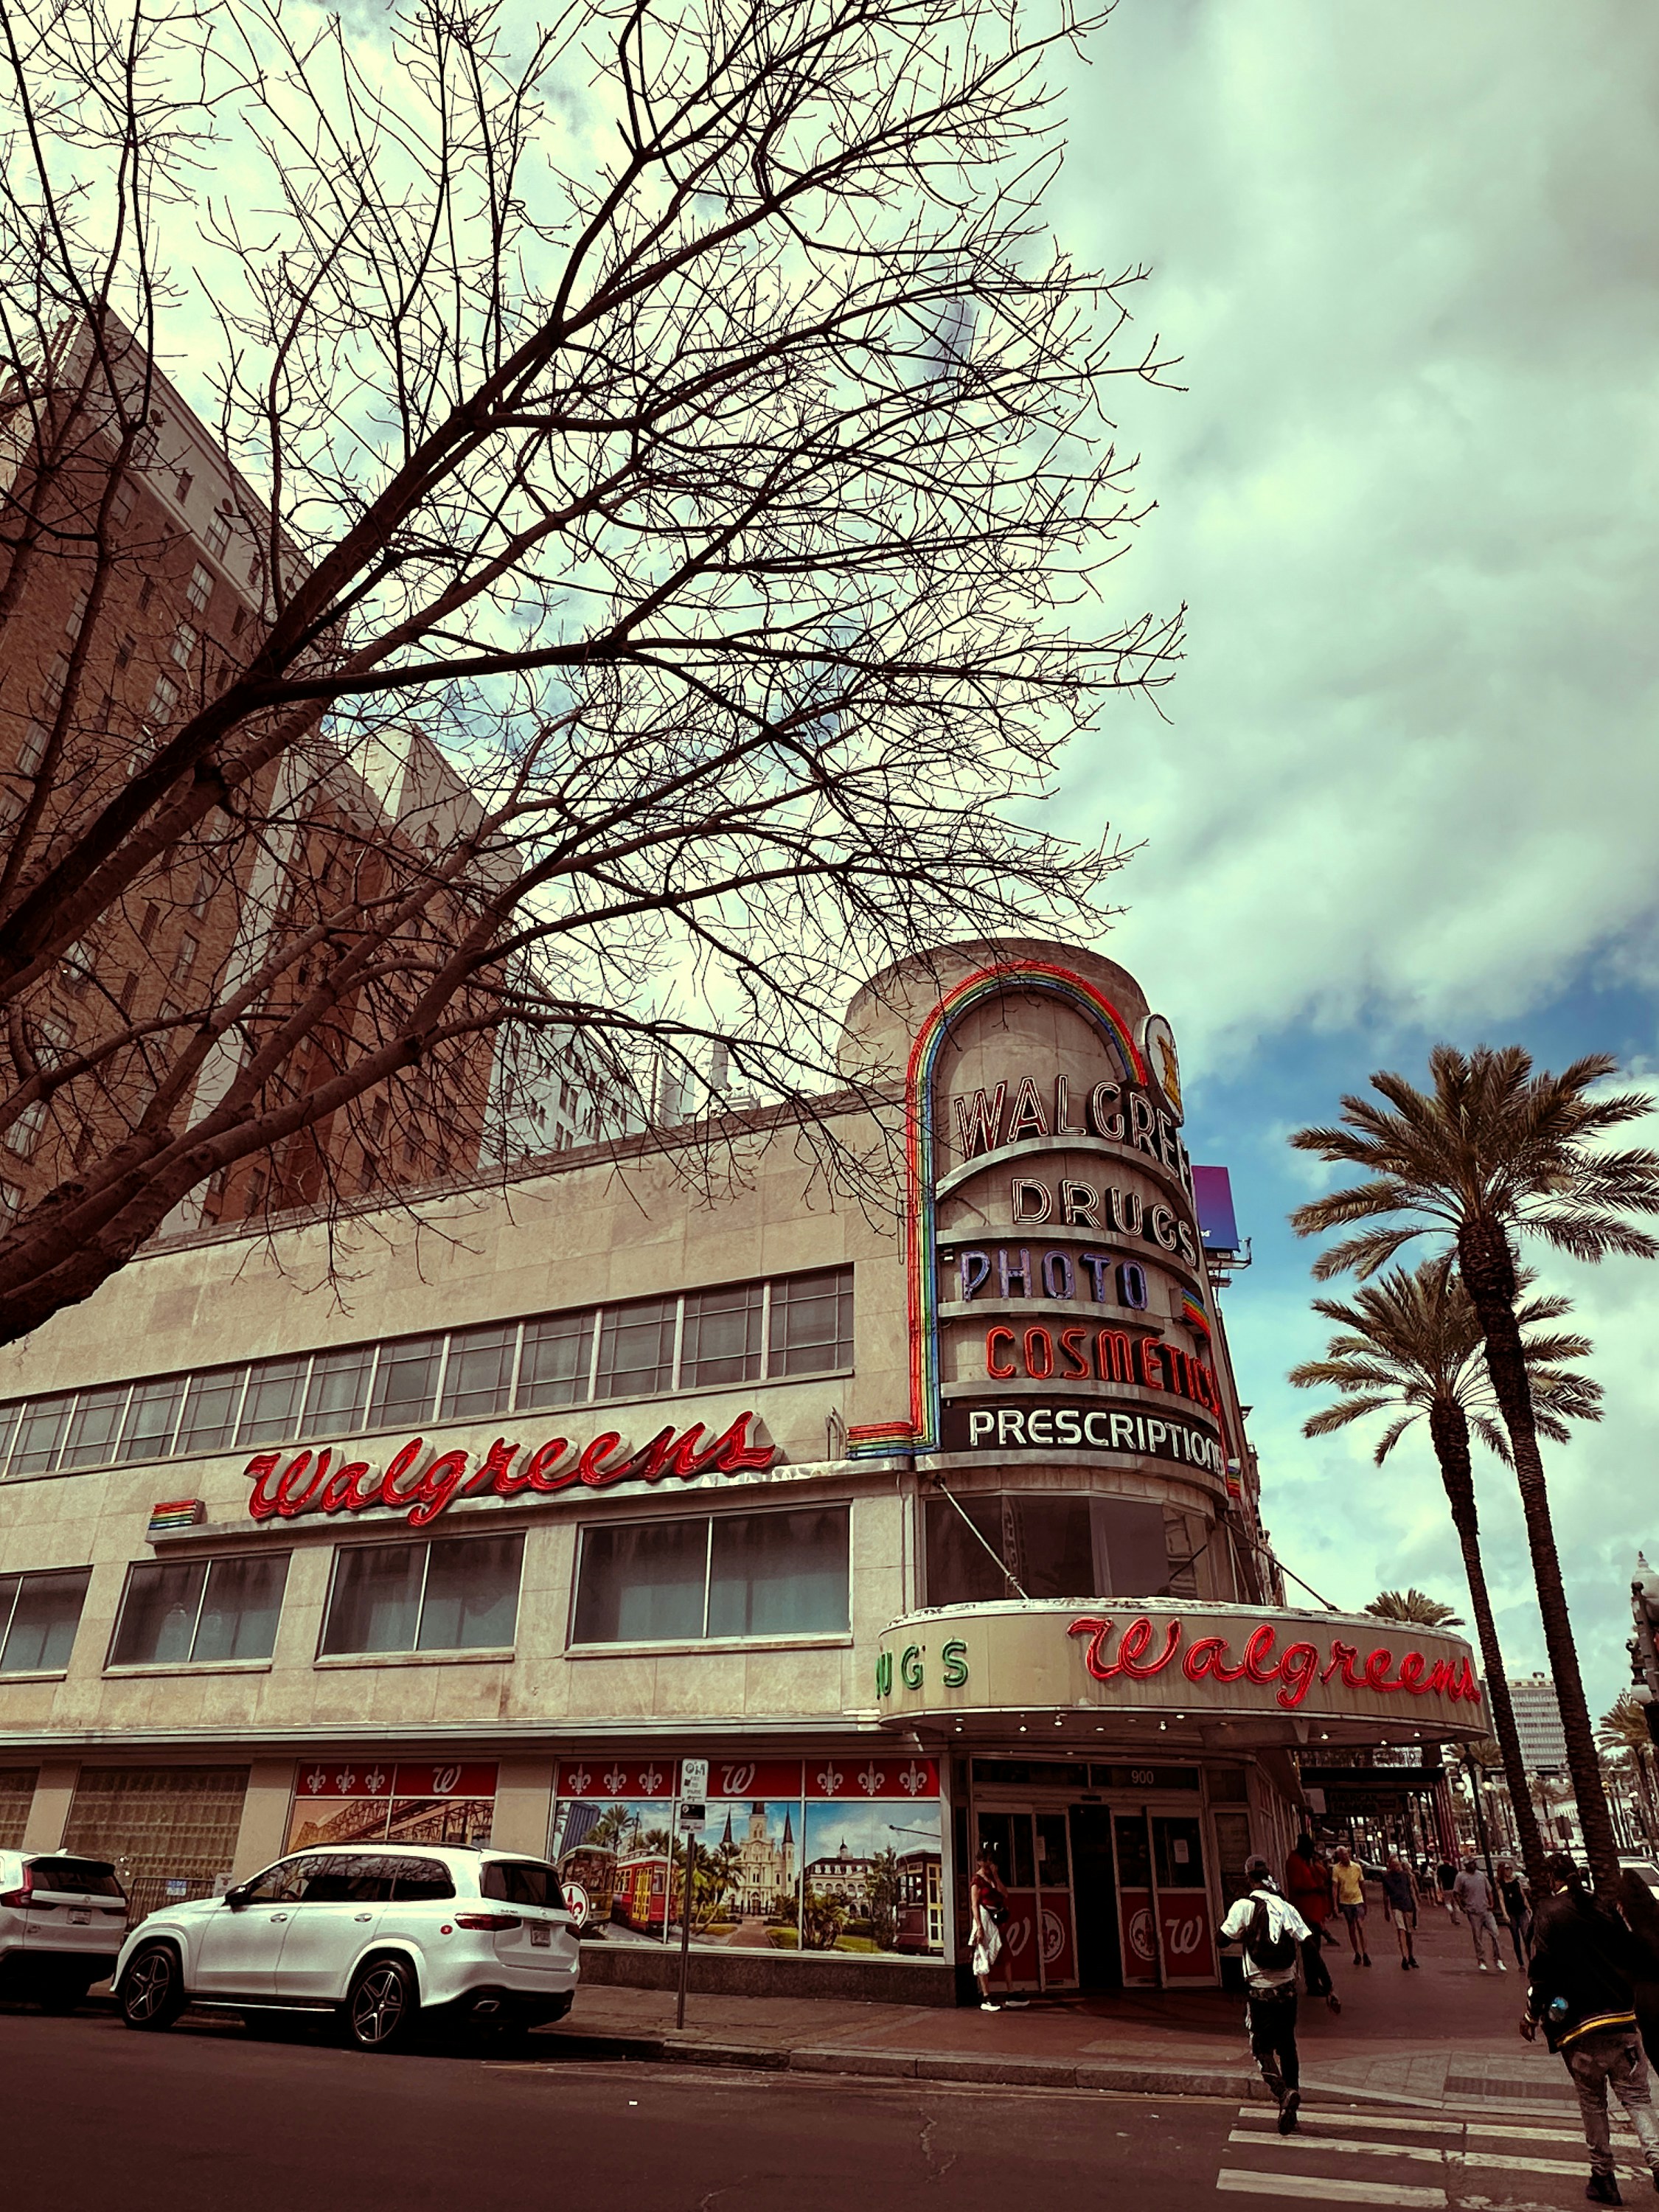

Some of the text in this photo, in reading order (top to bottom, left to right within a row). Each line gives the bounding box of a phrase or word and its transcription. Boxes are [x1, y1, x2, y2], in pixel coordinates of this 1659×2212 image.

[1010, 1178, 1199, 1268] DRUGS
[961, 1249, 1149, 1310] PHOTO
[243, 1410, 779, 1528] Walgreens
[967, 1408, 1225, 1477] PRESCRIPTIONS
[1066, 1615, 1482, 1708] Walgreens
[1131, 1770, 1154, 1785] 900
